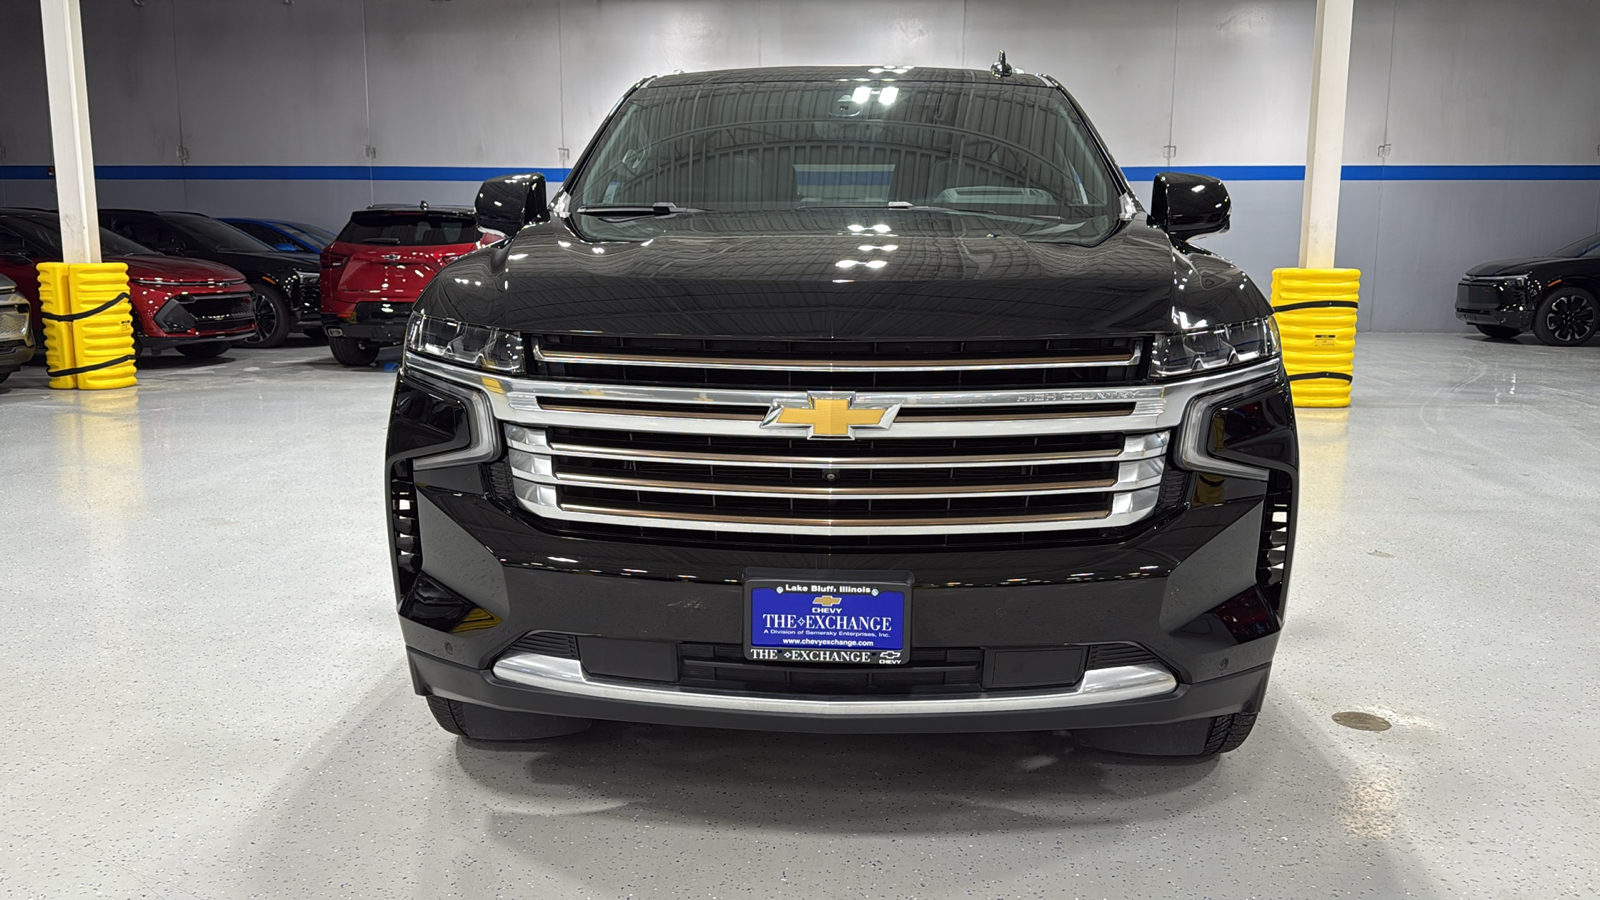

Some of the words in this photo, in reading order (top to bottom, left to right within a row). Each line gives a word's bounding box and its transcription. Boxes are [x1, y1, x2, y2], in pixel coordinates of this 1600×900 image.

[785, 584, 808, 592] Lake
[811, 585, 837, 593] Bluff,
[762, 614, 797, 628] THE
[805, 615, 892, 631] EXCHANGE
[782, 638, 874, 647] www.chevyexchange.com
[750, 649, 778, 659] THE
[791, 650, 871, 662] EXCHANGE
